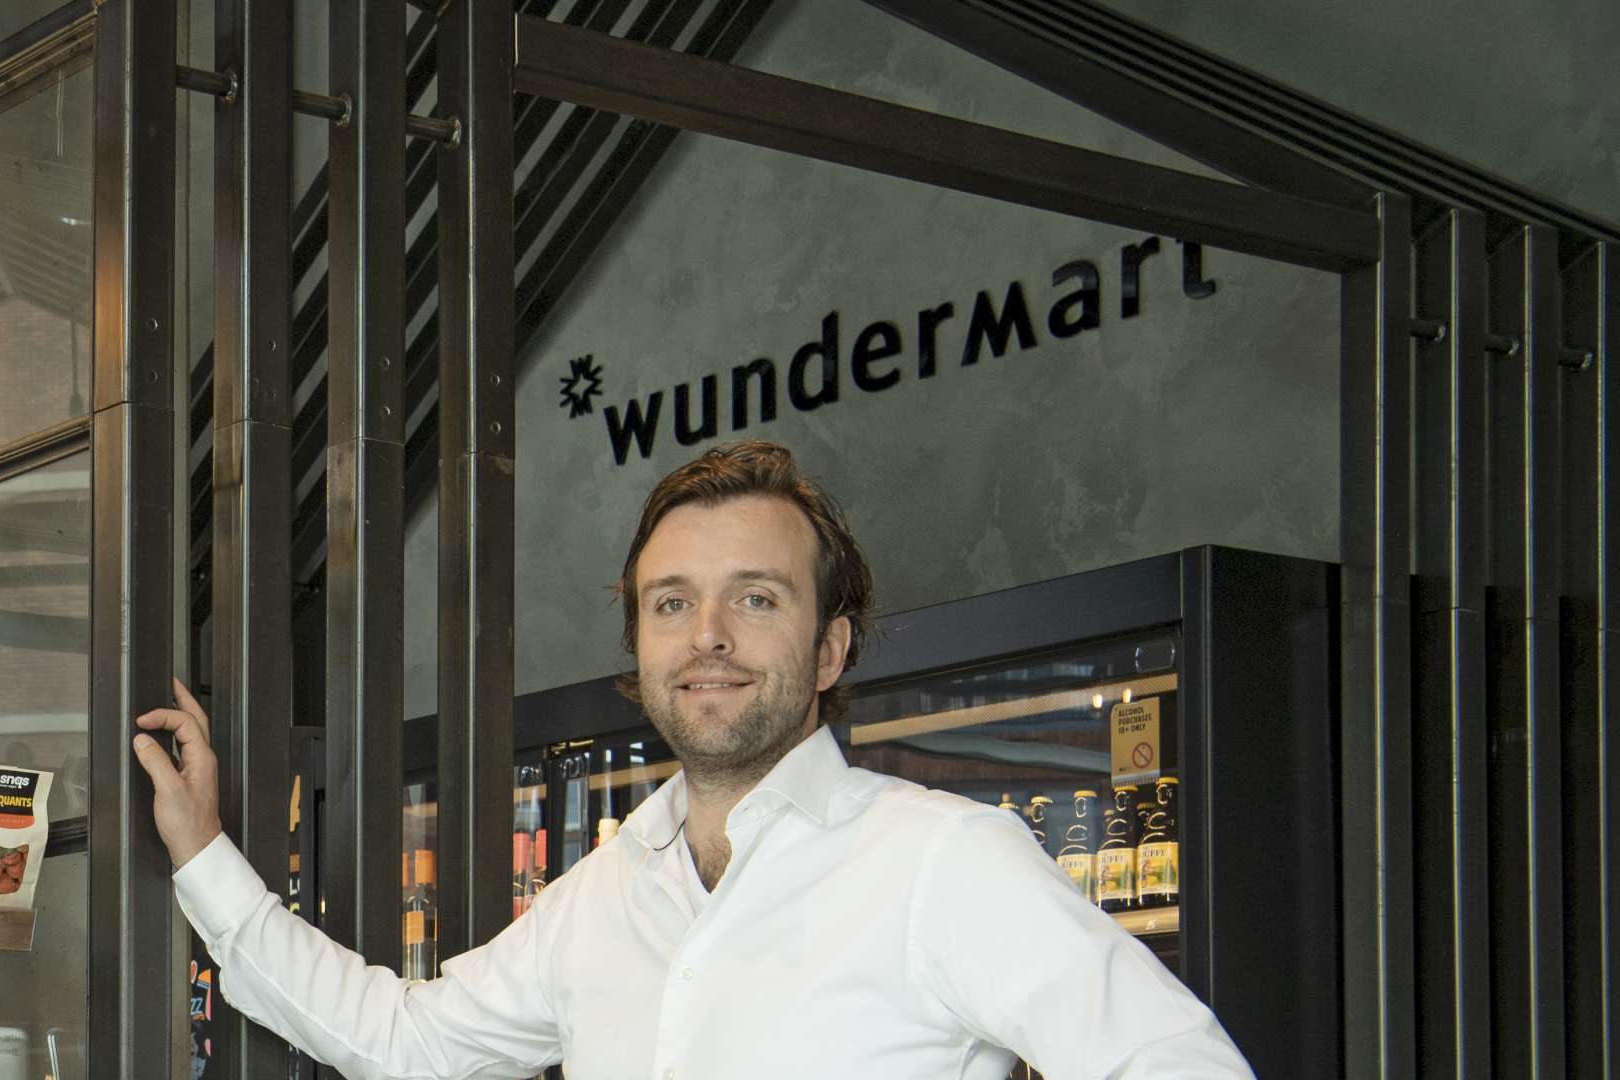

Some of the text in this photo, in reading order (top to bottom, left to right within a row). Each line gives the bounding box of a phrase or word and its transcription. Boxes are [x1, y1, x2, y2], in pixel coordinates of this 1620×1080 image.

[1118, 706, 1145, 717] ALCOHOL
[1131, 723, 1147, 732] ONLY
[0, 774, 30, 789] snqs
